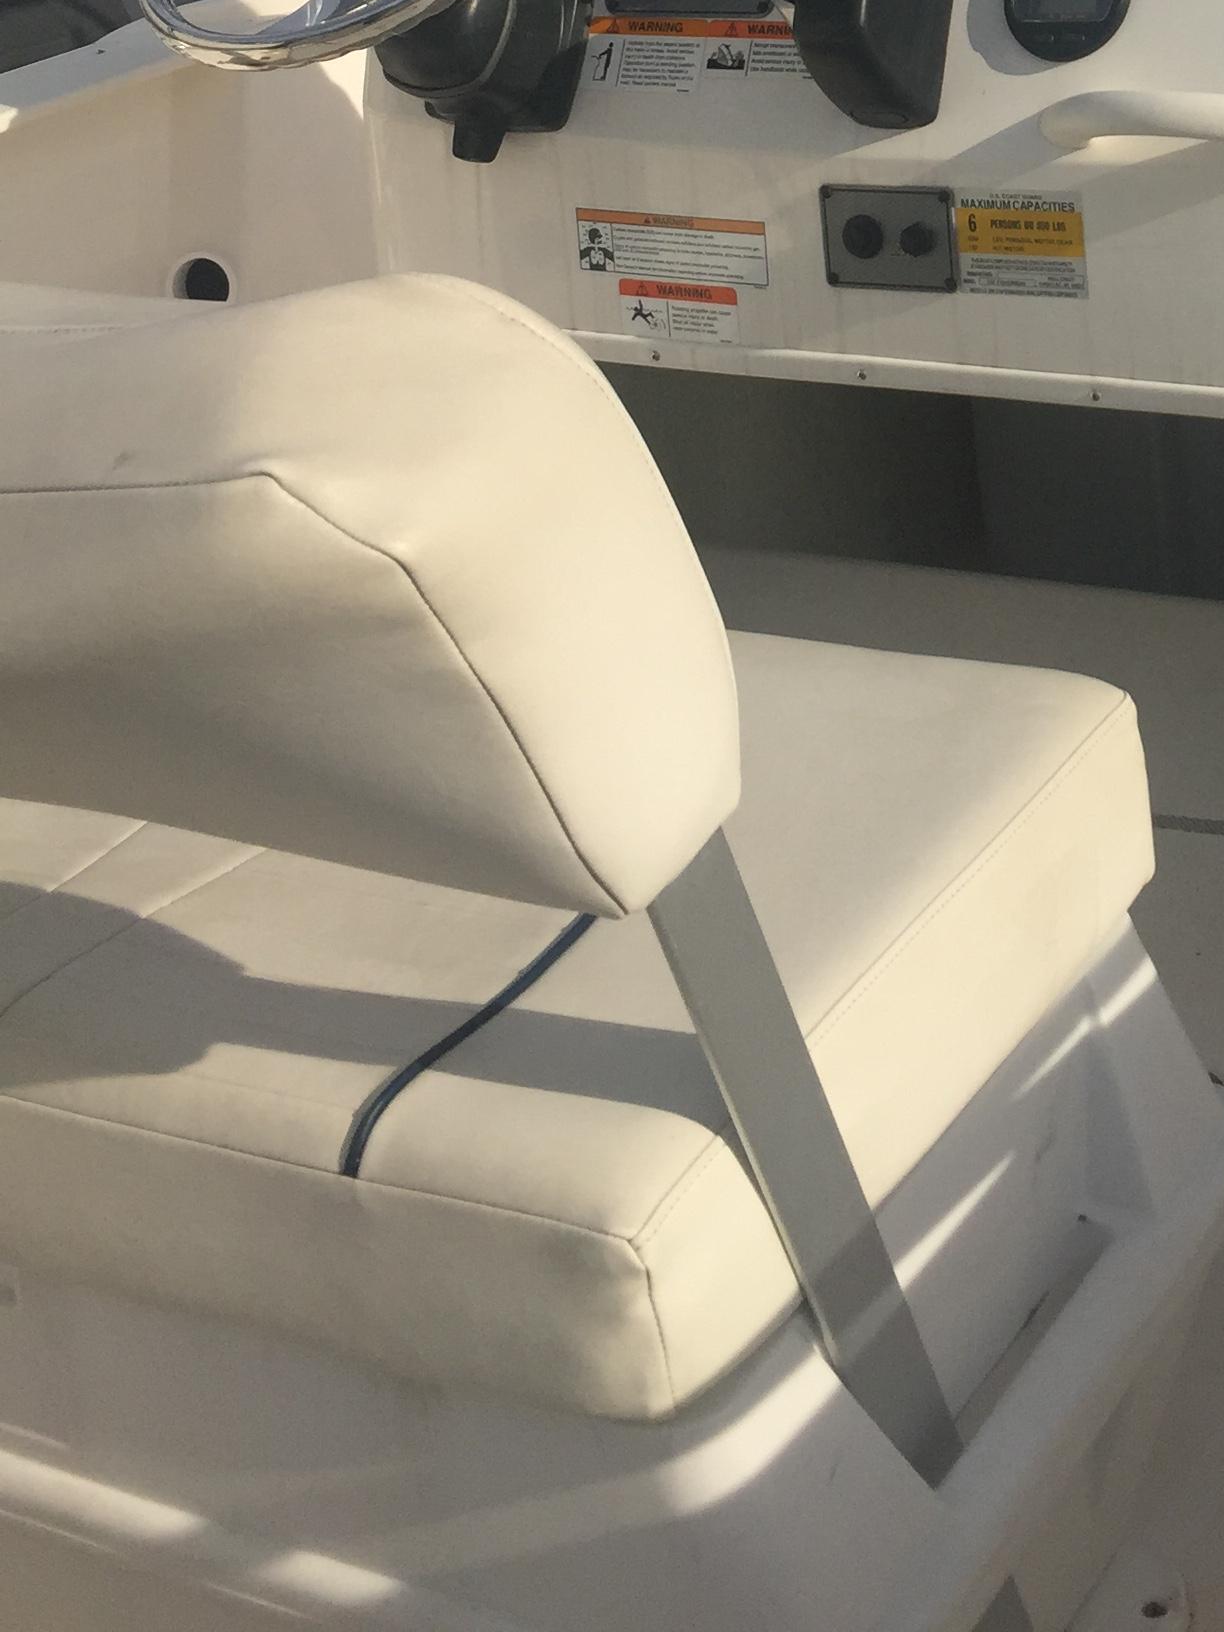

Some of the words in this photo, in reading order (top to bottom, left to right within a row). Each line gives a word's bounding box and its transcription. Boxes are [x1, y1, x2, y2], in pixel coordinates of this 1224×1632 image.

[628, 21, 684, 34] WARNING
[747, 24, 793, 36] WARNI
[961, 198, 1011, 210] MAXIMUM
[1012, 200, 1075, 213] CAPACITIES
[652, 217, 696, 229] WARNING
[968, 213, 977, 233] 6
[656, 285, 713, 300] WARNING
